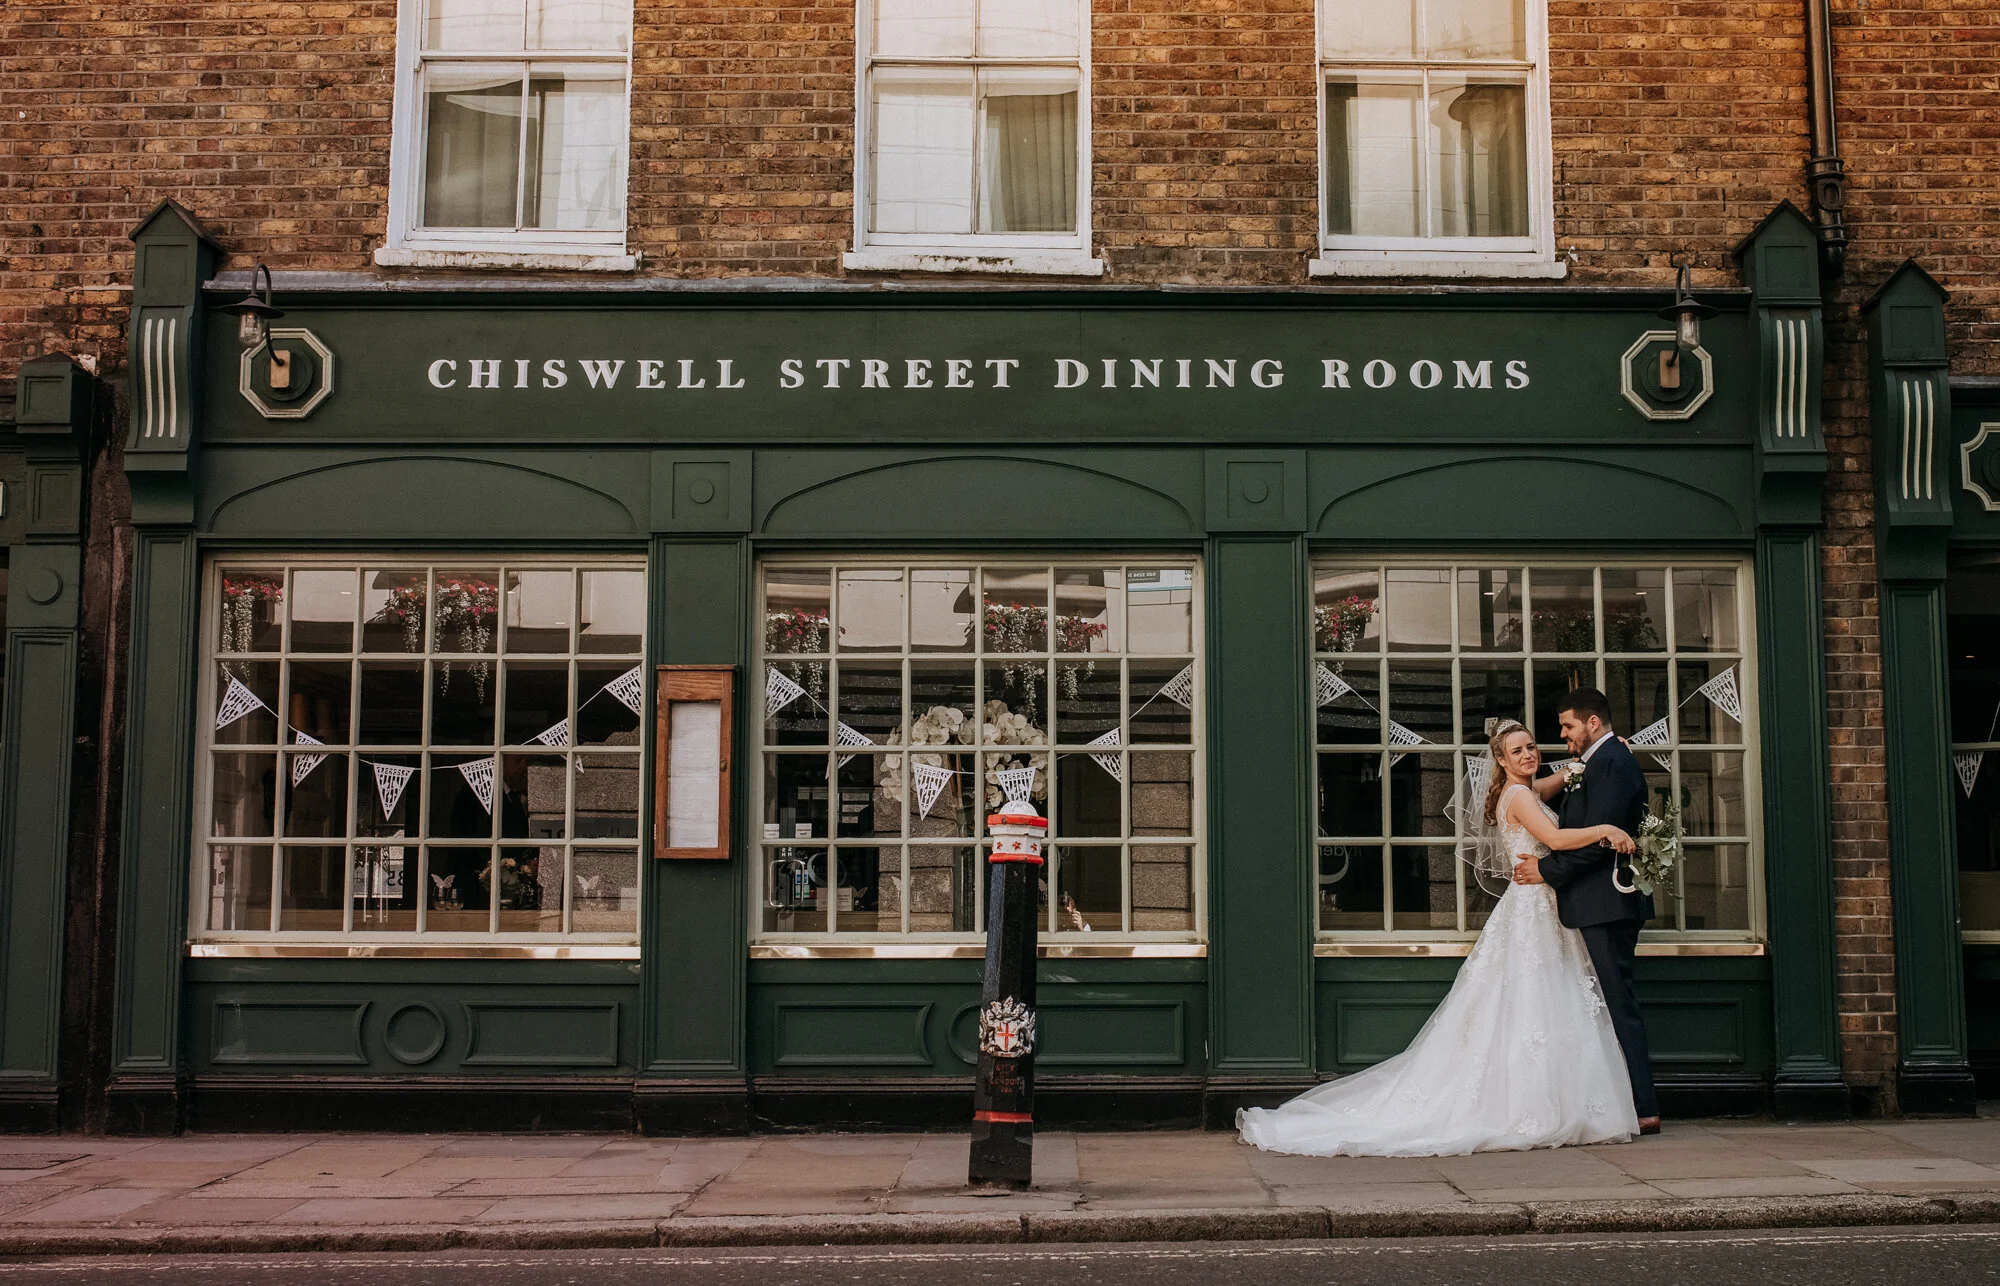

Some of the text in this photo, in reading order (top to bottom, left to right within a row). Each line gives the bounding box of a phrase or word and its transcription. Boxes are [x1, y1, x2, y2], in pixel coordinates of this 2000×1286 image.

[427, 358, 1529, 389] CHISWELL STREET DINING ROOMS
